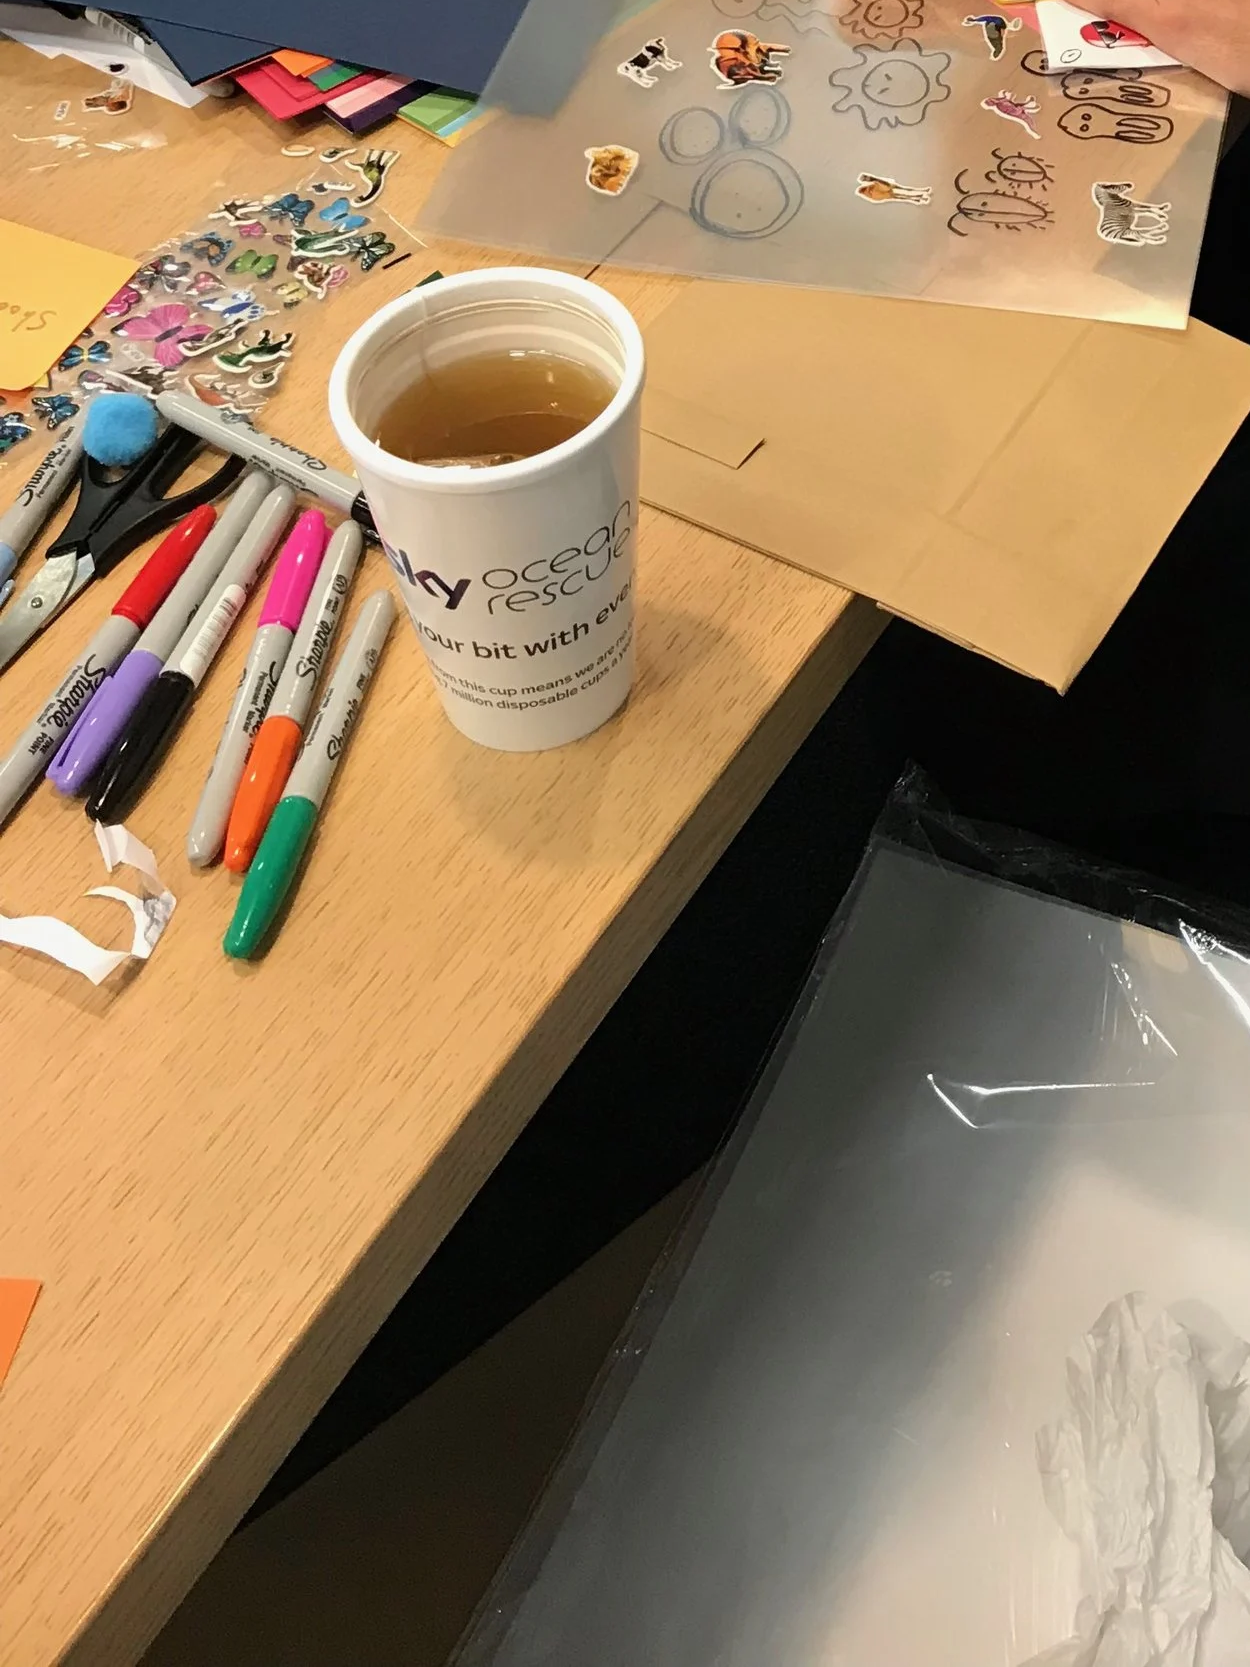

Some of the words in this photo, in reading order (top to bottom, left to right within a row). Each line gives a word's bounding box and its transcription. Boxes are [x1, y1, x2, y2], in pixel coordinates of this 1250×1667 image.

[482, 500, 631, 589] ocean
[488, 527, 631, 614] rescue
[296, 618, 335, 686] Sharpie
[472, 641, 517, 659] bit
[524, 623, 589, 656] with
[47, 653, 108, 728] Sharpie
[489, 687, 517, 698] cup
[521, 675, 573, 694] means
[575, 663, 594, 678] we
[496, 687, 578, 710] disposable
[581, 666, 610, 690] cups
